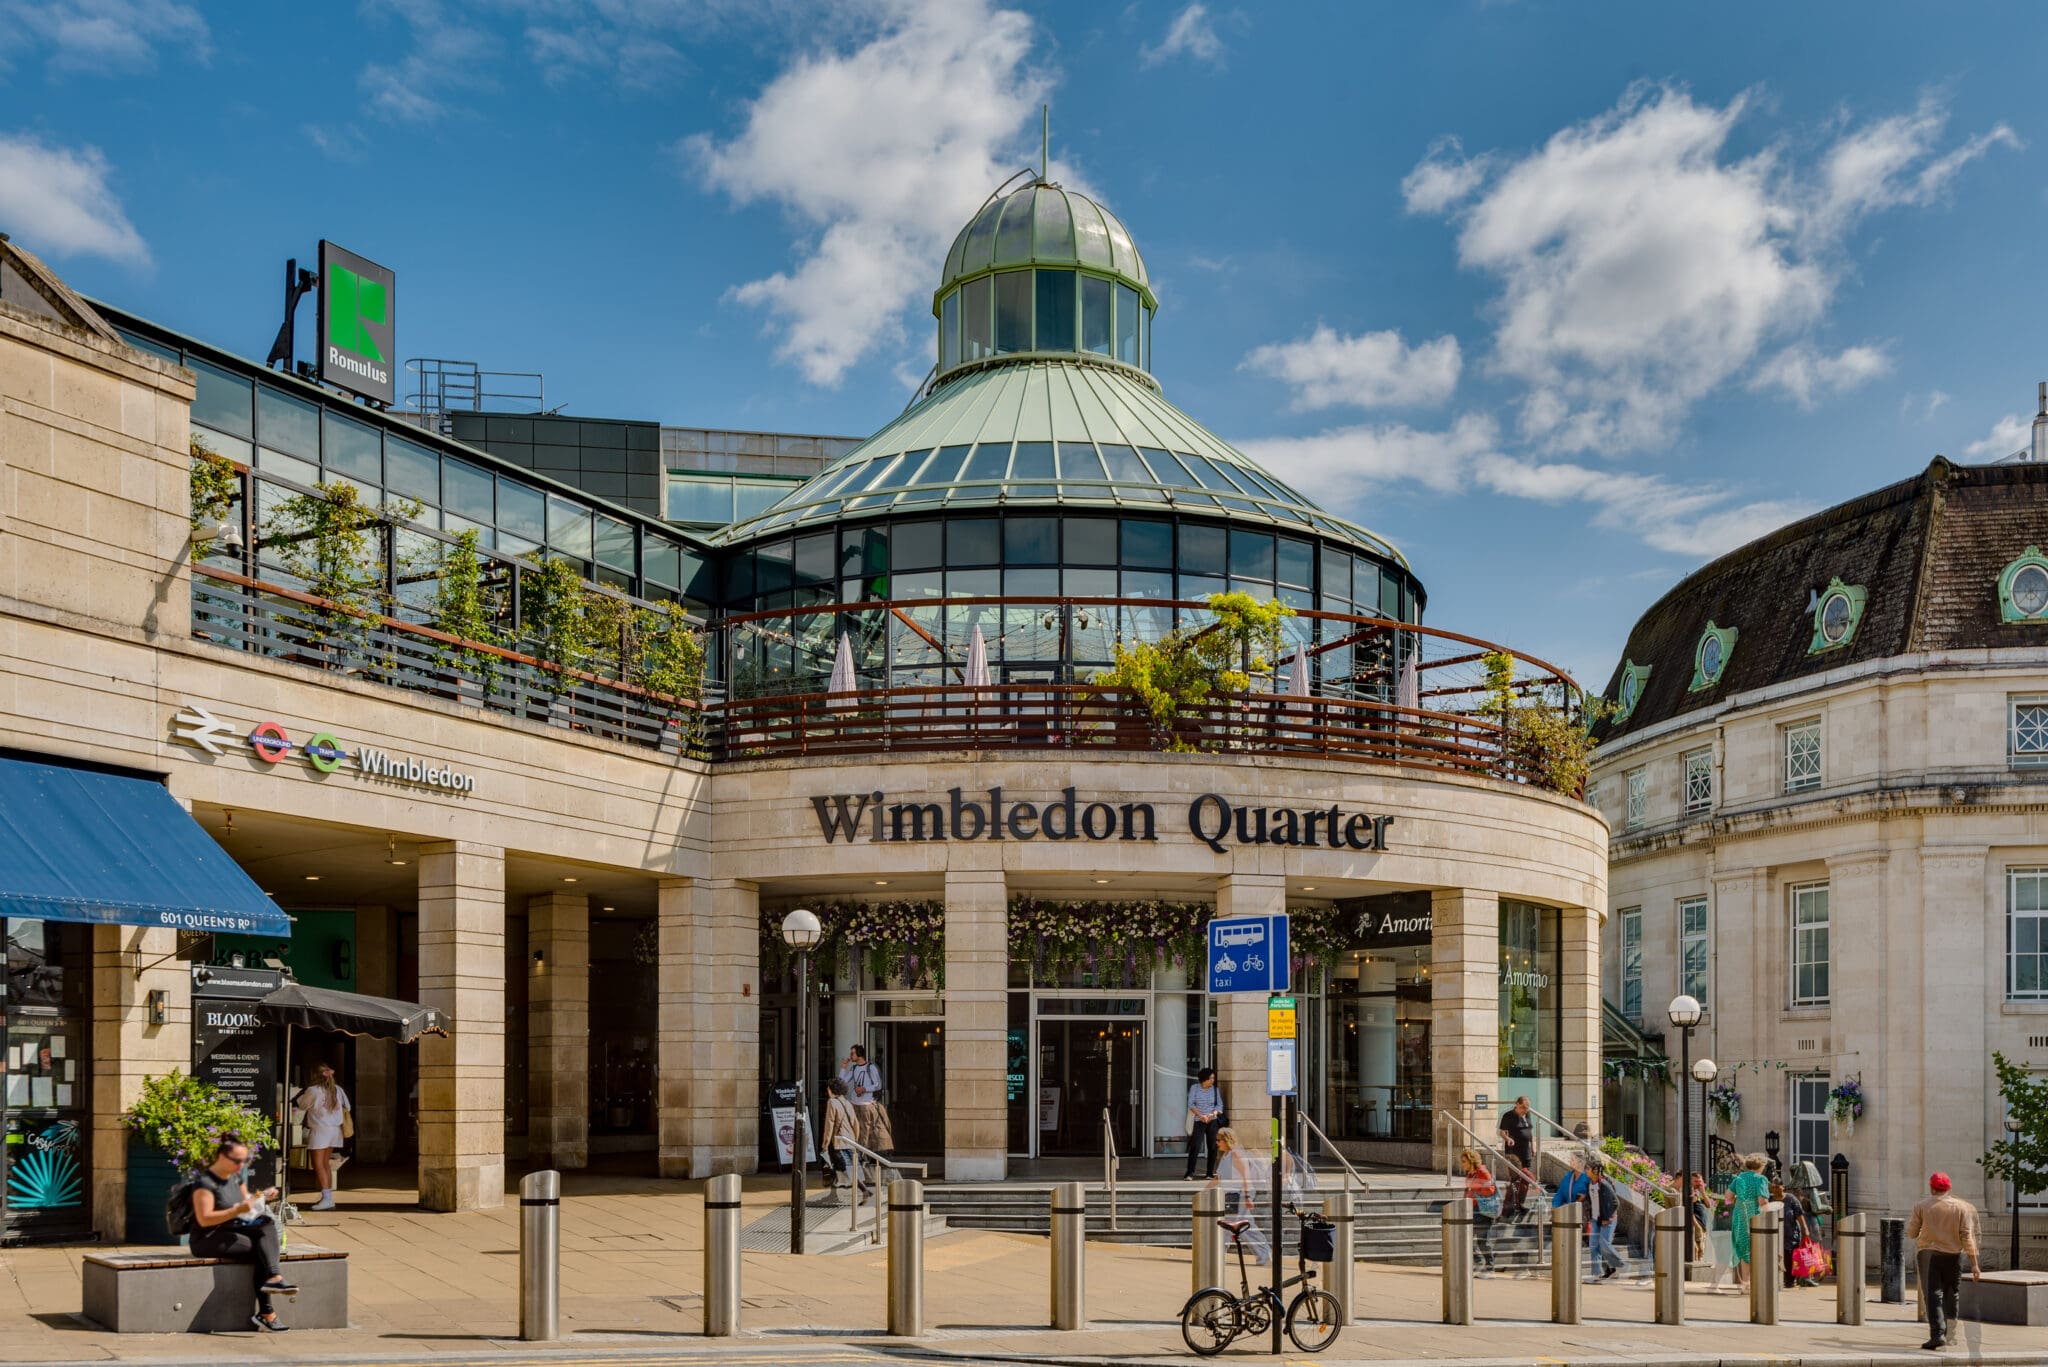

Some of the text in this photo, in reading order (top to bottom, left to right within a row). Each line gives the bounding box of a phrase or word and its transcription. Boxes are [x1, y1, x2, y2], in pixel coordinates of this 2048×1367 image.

[329, 346, 387, 384] Romulus
[252, 735, 291, 748] UNDERGROUND
[318, 747, 336, 756] TRAMS
[359, 746, 476, 792] Wimbledon
[809, 786, 1394, 854] Wimbledon Quarter
[160, 911, 180, 924] 601
[184, 914, 236, 929] QUEEN'S
[1215, 976, 1232, 987] taxi
[1503, 960, 1548, 989] Amorino
[206, 1012, 261, 1028] BLOOMS
